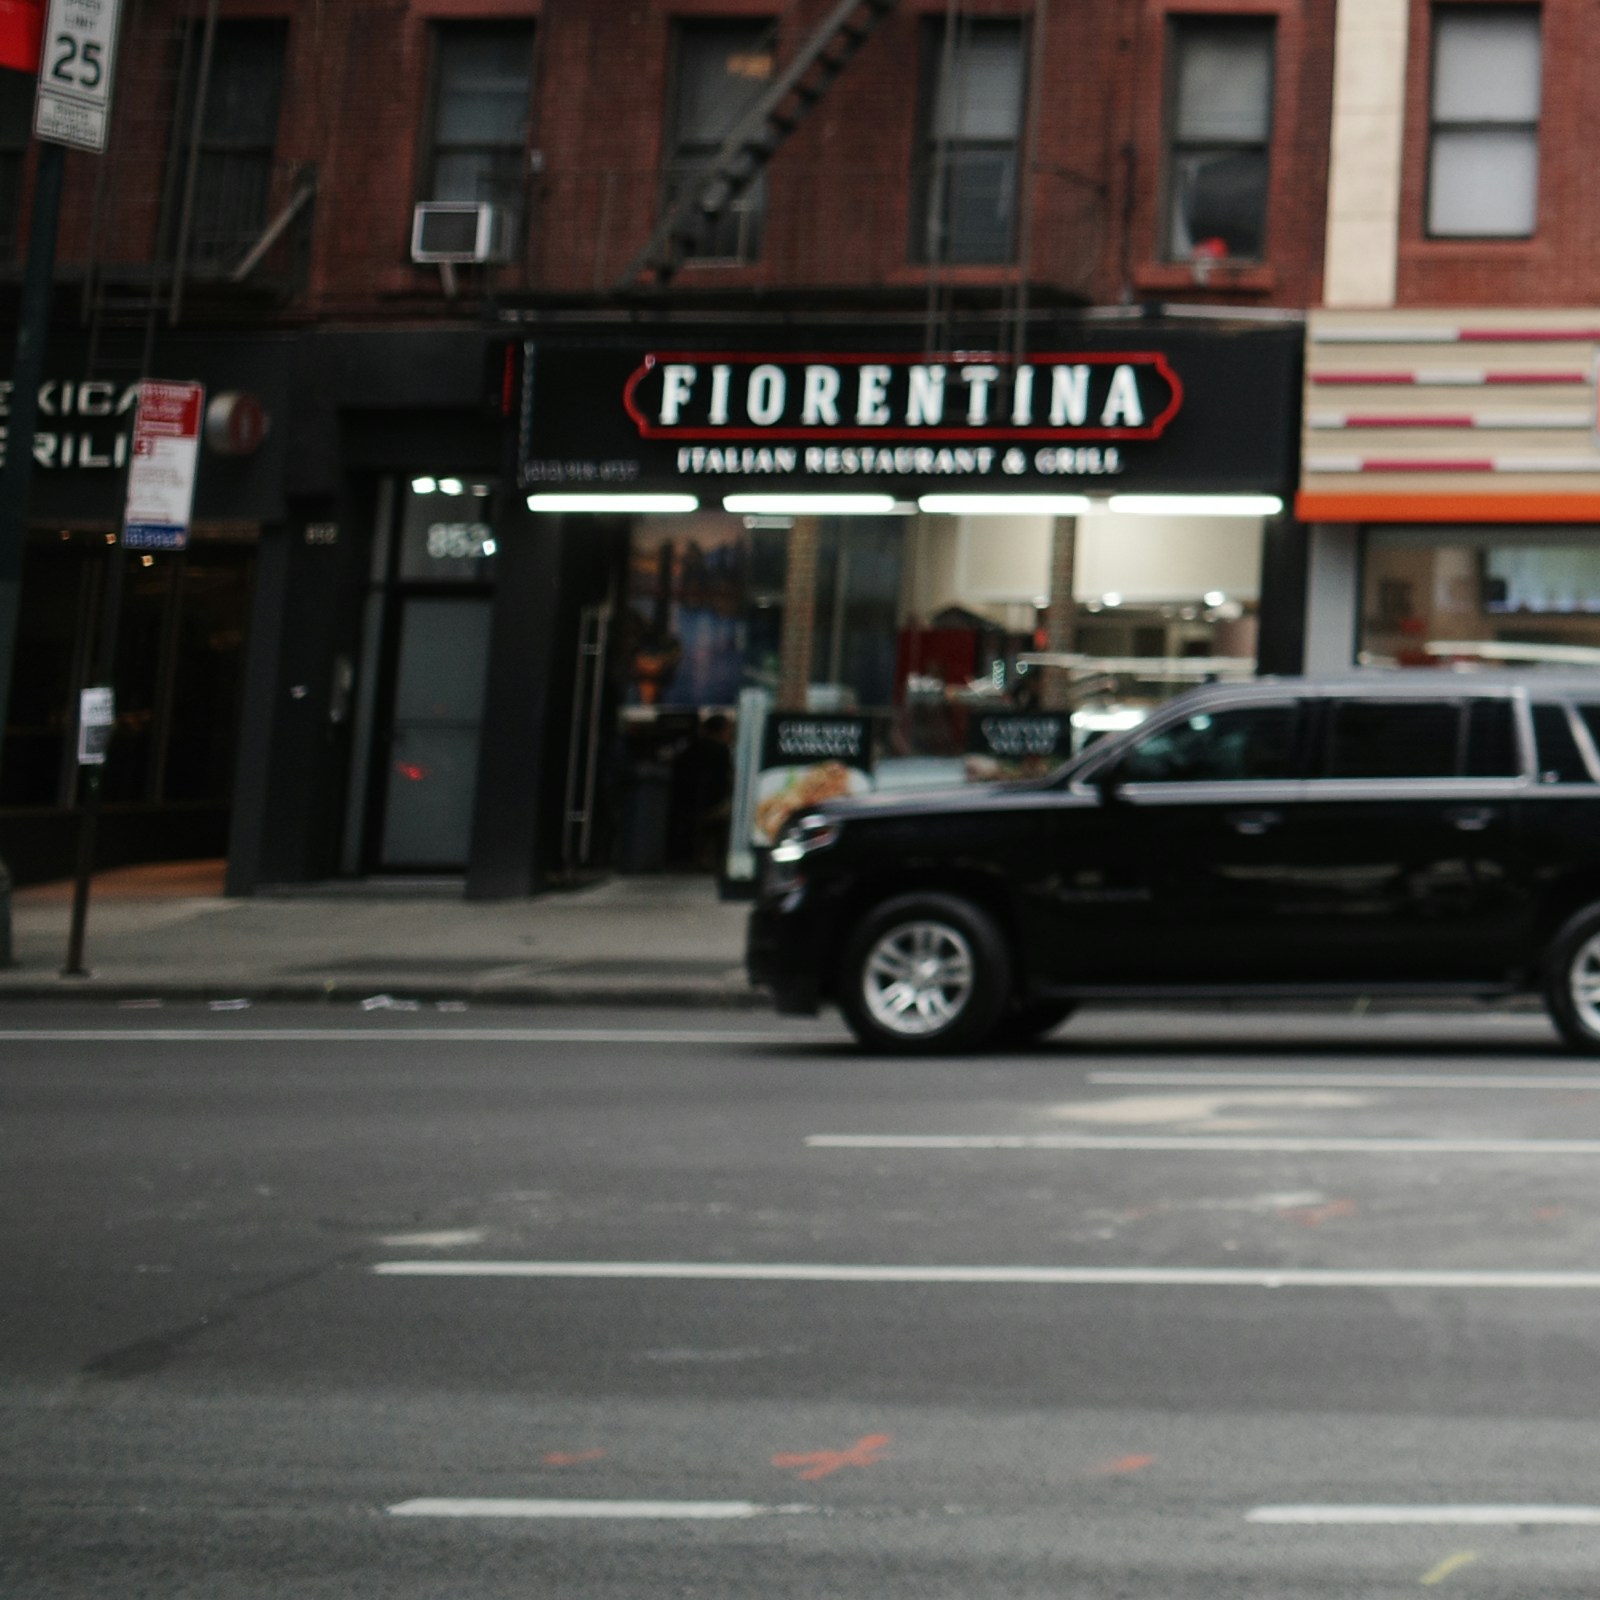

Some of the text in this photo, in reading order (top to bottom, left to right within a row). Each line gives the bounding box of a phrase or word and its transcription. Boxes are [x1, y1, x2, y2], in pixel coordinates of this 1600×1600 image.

[52, 34, 102, 88] 25
[660, 364, 1144, 427] FIORENTINA
[677, 447, 1122, 476] ITALIAN RESTAURANT & GRILL
